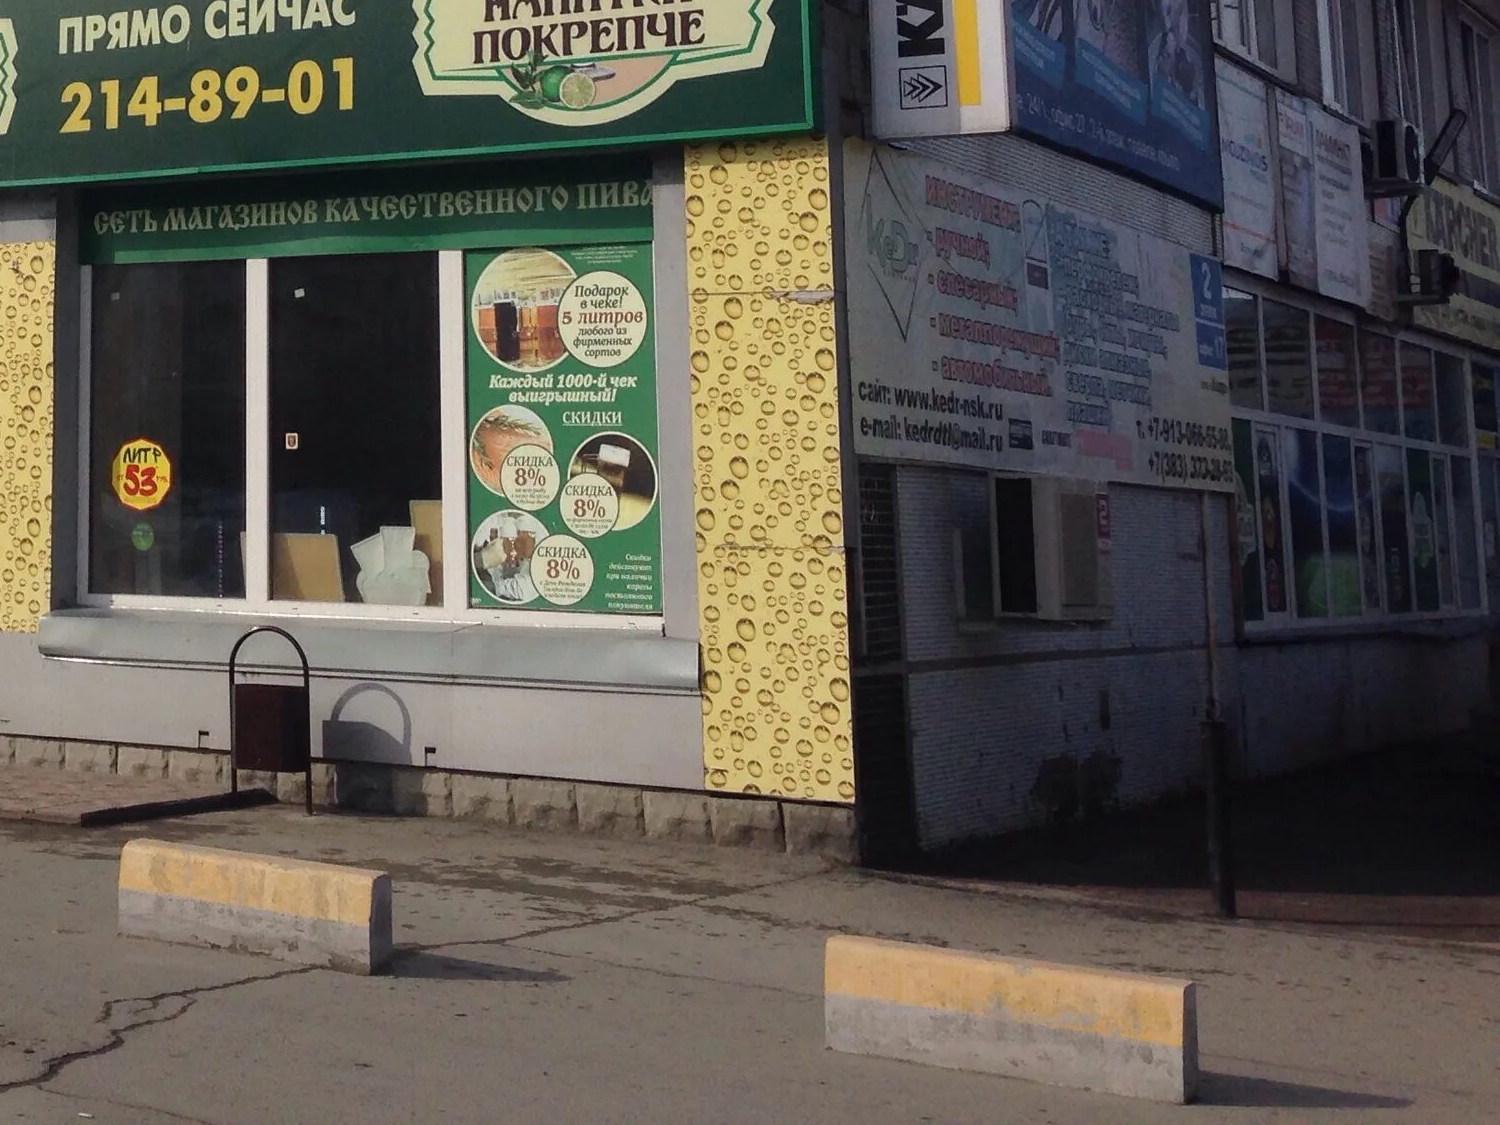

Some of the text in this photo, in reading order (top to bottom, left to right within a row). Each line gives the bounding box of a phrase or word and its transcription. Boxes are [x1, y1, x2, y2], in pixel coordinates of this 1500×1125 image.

[58, 0, 190, 56] ПРЯМО
[472, 9, 706, 65] ПОКРЕПЧЕ
[59, 58, 356, 135] 214-89-01
[93, 208, 159, 236] СЕТЬ
[162, 200, 319, 233] МАГАЗИНОВ
[322, 185, 570, 226] КАЧЕСТВЕННОГО
[1200, 262, 1213, 301] 2
[574, 283, 630, 300] Подарок
[580, 294, 622, 310] в чеке!
[561, 308, 644, 327] 5 литров
[578, 325, 628, 339] любого из
[573, 336, 633, 350] фирменных
[583, 346, 622, 359] сортов
[489, 373, 638, 390] Каждый 1000-й чек
[508, 388, 618, 405] выигрышный!
[858, 378, 1004, 420] сайт: www.kedr-nsk.ru
[562, 410, 623, 425] СКИДКИ
[859, 416, 902, 439] e-mail:
[122, 447, 161, 463] ЛИТР
[506, 454, 554, 469] СКИДКА
[123, 464, 158, 496] 53
[514, 467, 547, 488] 8%
[564, 483, 613, 499] СКИДКА
[573, 498, 606, 519] 8%
[537, 545, 588, 560] СКИДКА
[546, 559, 580, 580] 8%
